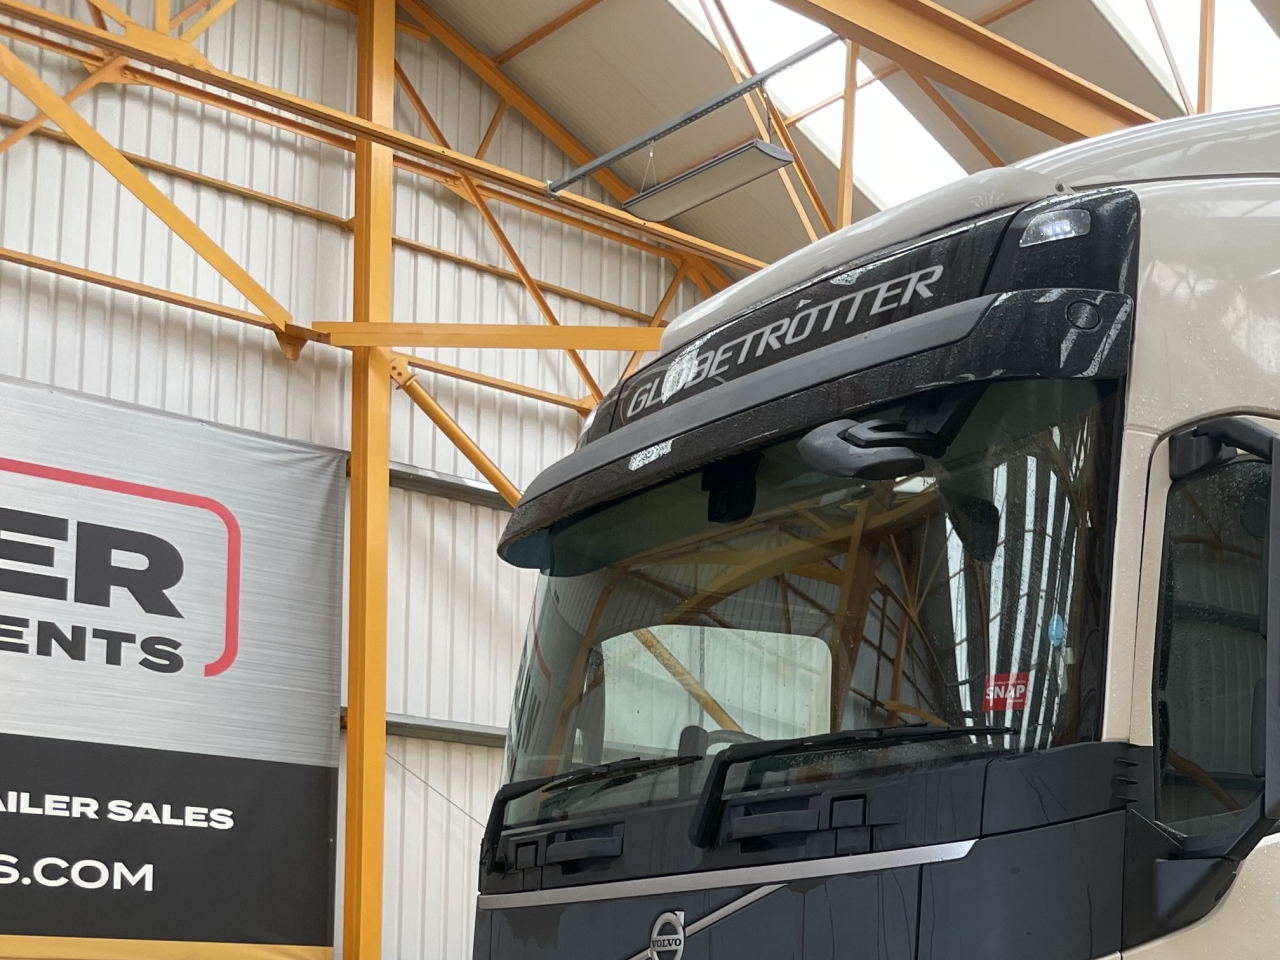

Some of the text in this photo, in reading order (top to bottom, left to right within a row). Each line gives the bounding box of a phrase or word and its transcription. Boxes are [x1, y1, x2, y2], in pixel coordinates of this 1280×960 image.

[985, 684, 1026, 700] SNAP
[0, 791, 235, 830] ILER SALES
[652, 937, 682, 948] VOLVO
